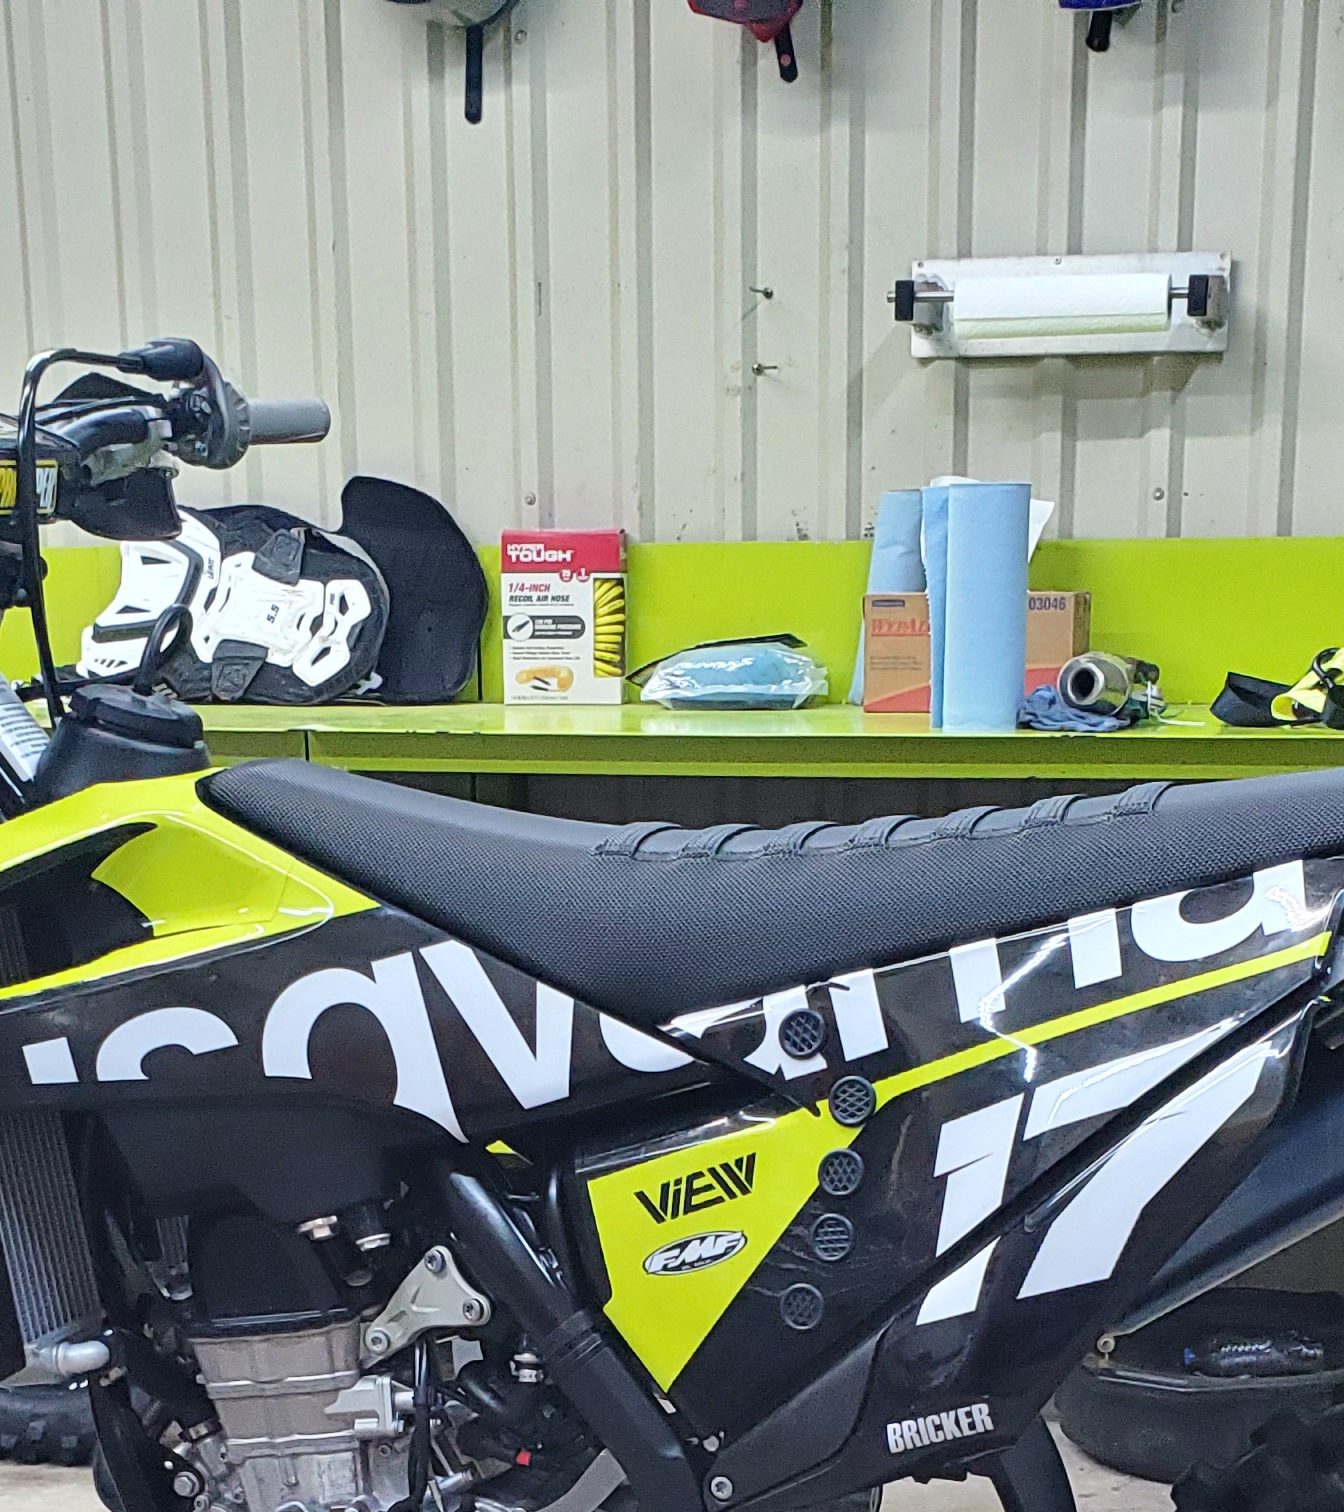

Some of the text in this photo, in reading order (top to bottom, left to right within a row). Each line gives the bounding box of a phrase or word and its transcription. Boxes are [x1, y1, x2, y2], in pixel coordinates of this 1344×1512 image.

[509, 549, 572, 563] TOUGH
[508, 582, 551, 593] 1/4-INCH
[509, 594, 570, 603] RECOIL AIR HOSE
[1029, 596, 1067, 611] 03046
[916, 1014, 1273, 1326] 17
[647, 1231, 743, 1274] FMF
[886, 1404, 993, 1454] BRICKER
